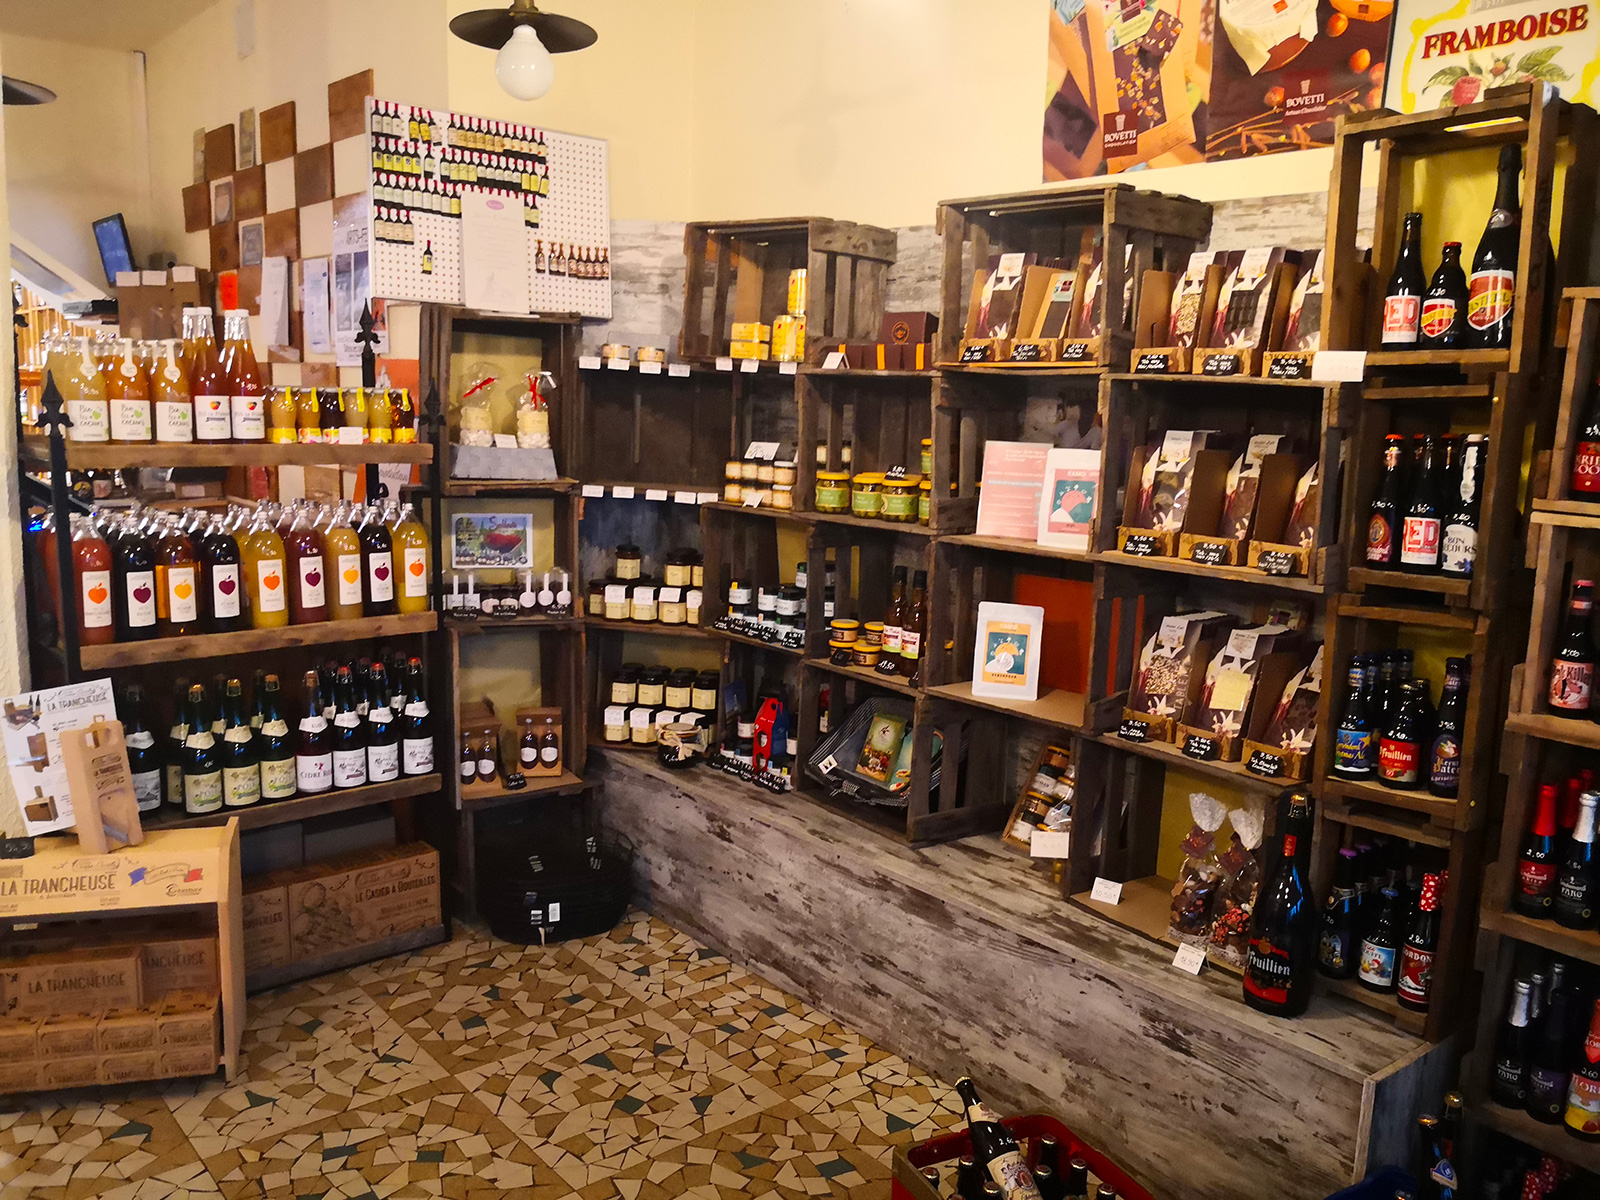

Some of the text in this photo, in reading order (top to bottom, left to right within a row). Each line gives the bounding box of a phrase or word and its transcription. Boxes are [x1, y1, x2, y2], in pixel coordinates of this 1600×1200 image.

[1421, 4, 1588, 59] FRAMBOISE
[1286, 92, 1325, 109] BOVETTI
[1104, 129, 1137, 144] BOVETTI
[1, 880, 19, 896] LA
[23, 873, 117, 895] TRANCHEUSE
[28, 970, 126, 994] LA TRANCHEUSE
